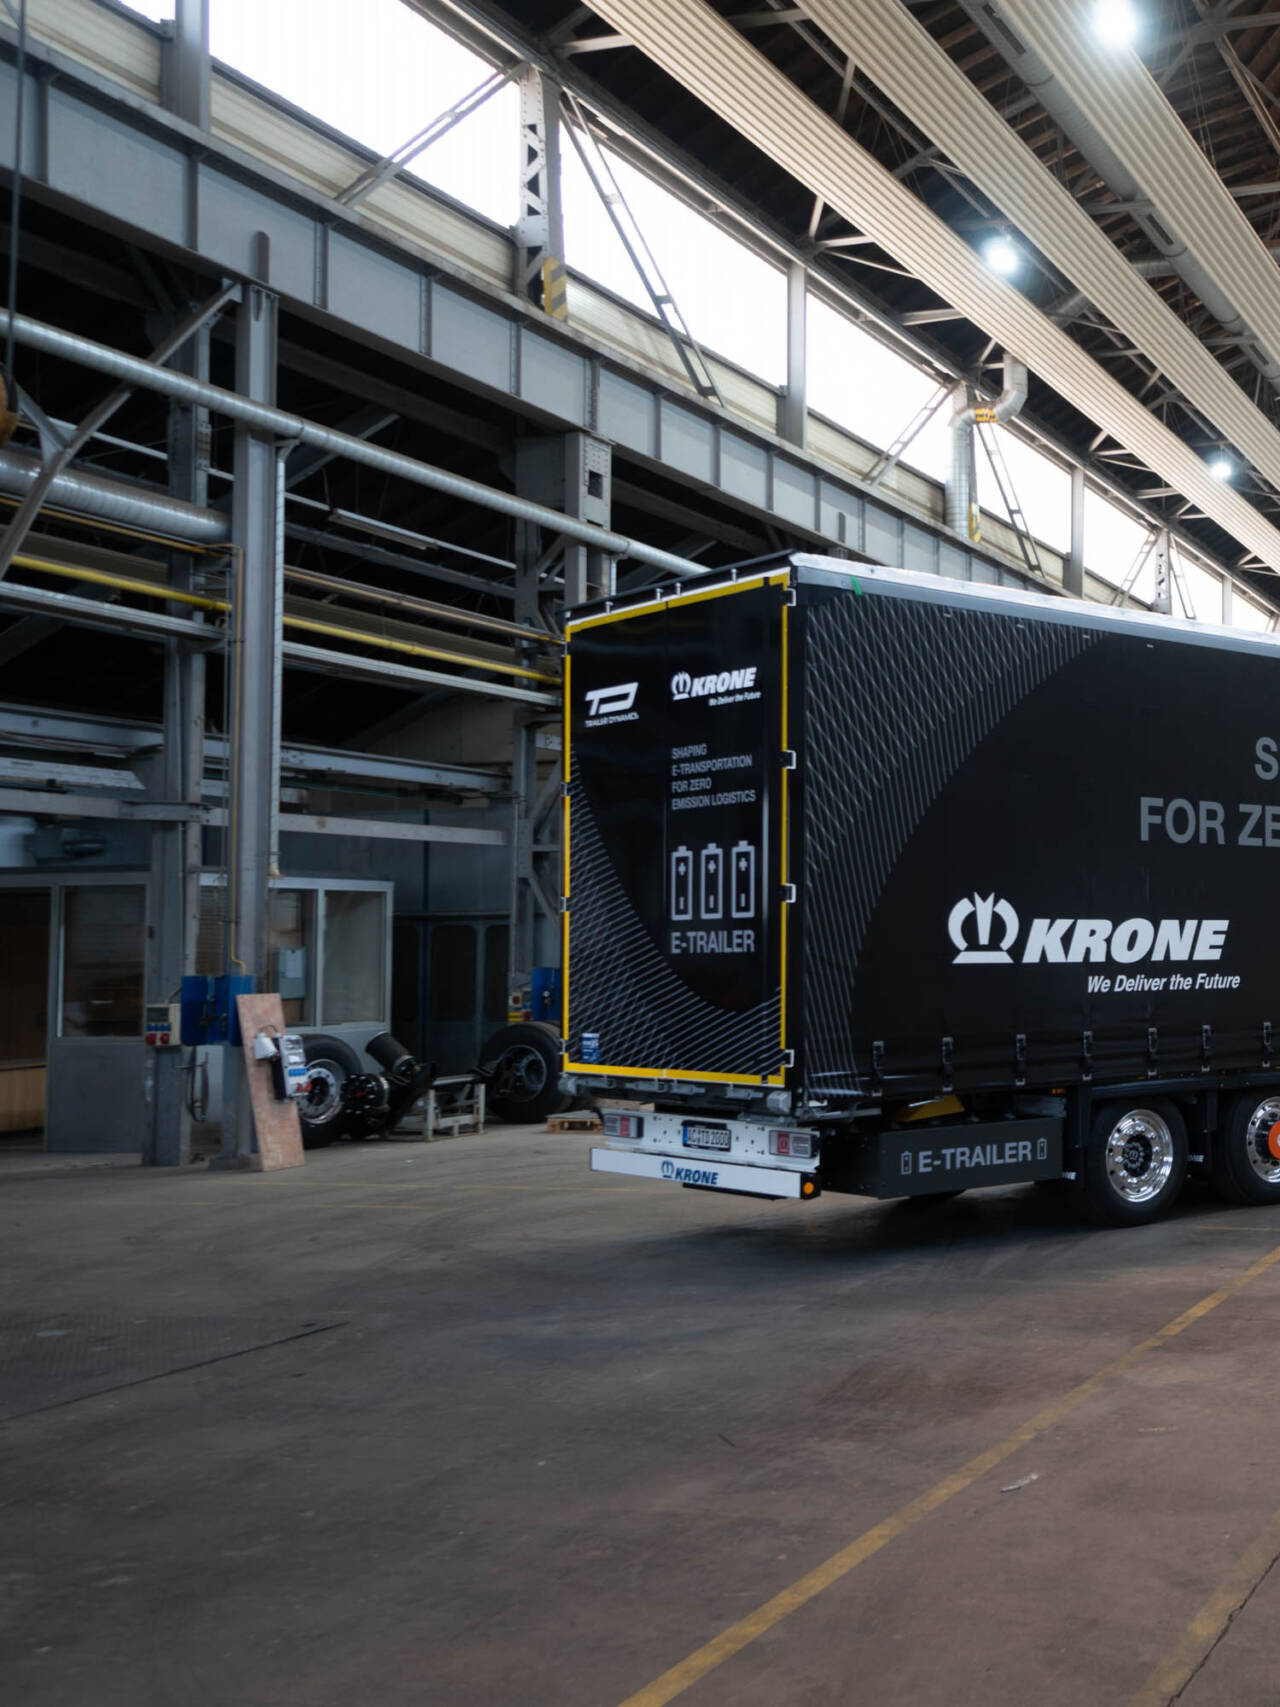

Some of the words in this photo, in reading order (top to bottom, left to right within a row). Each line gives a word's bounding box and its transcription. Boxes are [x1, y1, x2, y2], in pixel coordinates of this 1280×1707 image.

[691, 667, 757, 697] KRONE
[672, 743, 707, 760] SHAPING
[672, 754, 753, 777] E-TRANSPORTATION
[672, 781, 688, 794] FOR
[689, 777, 712, 791] ZERO
[672, 794, 710, 810] EMISSION
[711, 789, 756, 806] LOGISTICS
[1139, 796, 1226, 845] FOR
[671, 929, 755, 954] E-TRAILER
[1021, 917, 1230, 964] KRONE
[1087, 975, 1110, 993] We
[1114, 974, 1167, 992] Deliver
[1169, 974, 1192, 990] the
[1195, 973, 1241, 990] Future
[918, 1140, 1032, 1173] E-TRAILER
[675, 1167, 719, 1185] KRONE
